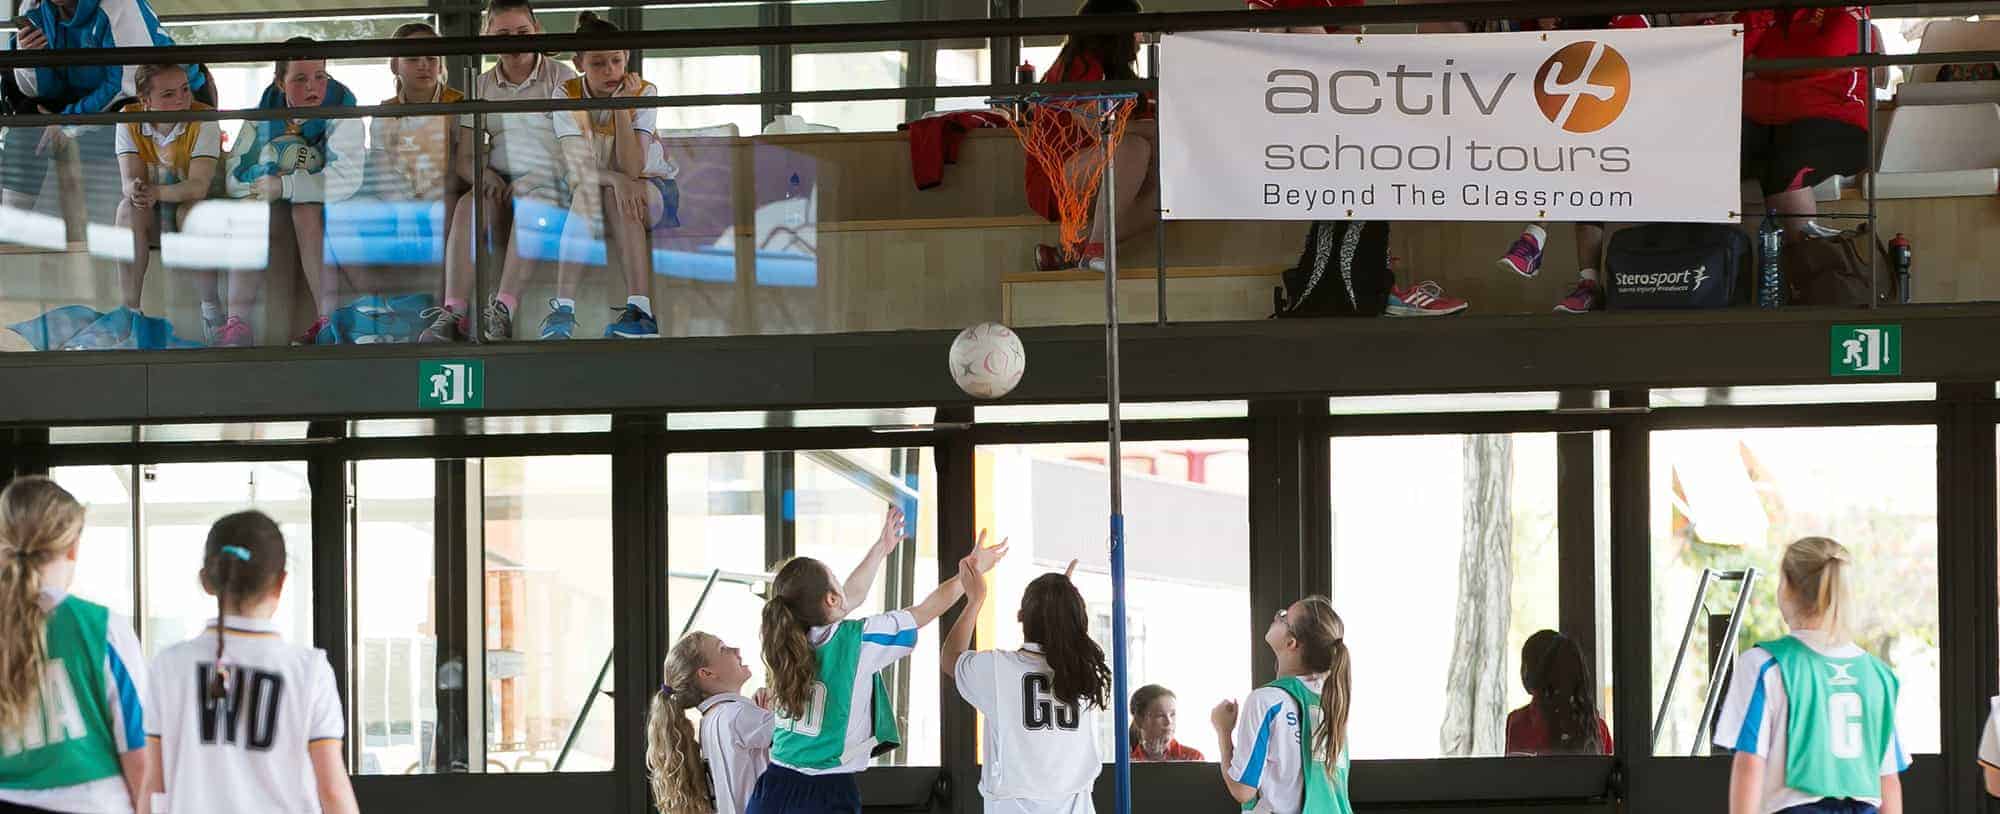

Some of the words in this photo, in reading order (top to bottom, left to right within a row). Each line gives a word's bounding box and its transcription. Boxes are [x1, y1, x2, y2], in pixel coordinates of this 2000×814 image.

[1264, 59, 1517, 116] activ
[1264, 135, 1452, 171] school
[1465, 140, 1631, 172] tours
[1264, 184, 1375, 211] Beyond
[1391, 184, 1446, 206] The
[1462, 184, 1633, 207] Classroom
[1615, 269, 1691, 287] Sterosport
[196, 660, 284, 752] WD
[1828, 692, 1863, 759] C
